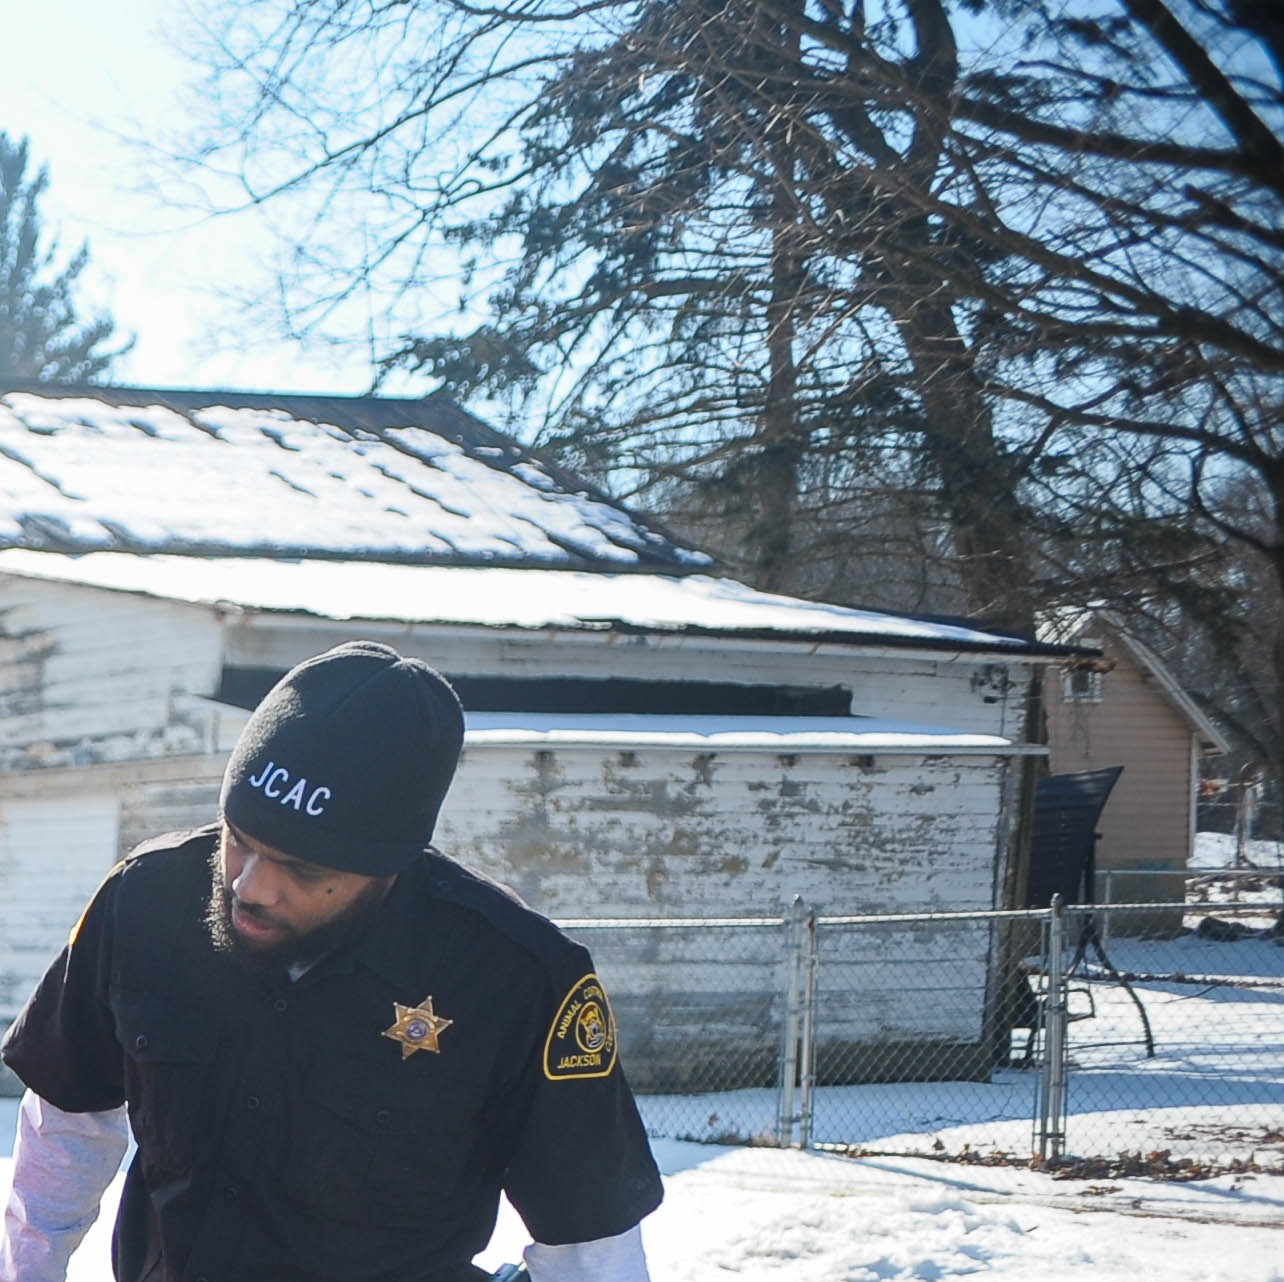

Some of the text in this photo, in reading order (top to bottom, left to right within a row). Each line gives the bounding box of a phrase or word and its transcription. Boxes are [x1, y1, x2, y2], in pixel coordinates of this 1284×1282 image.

[248, 761, 331, 816] JCAC
[556, 999, 583, 1040] ANIMAL
[556, 1053, 601, 1070] JACKSON
